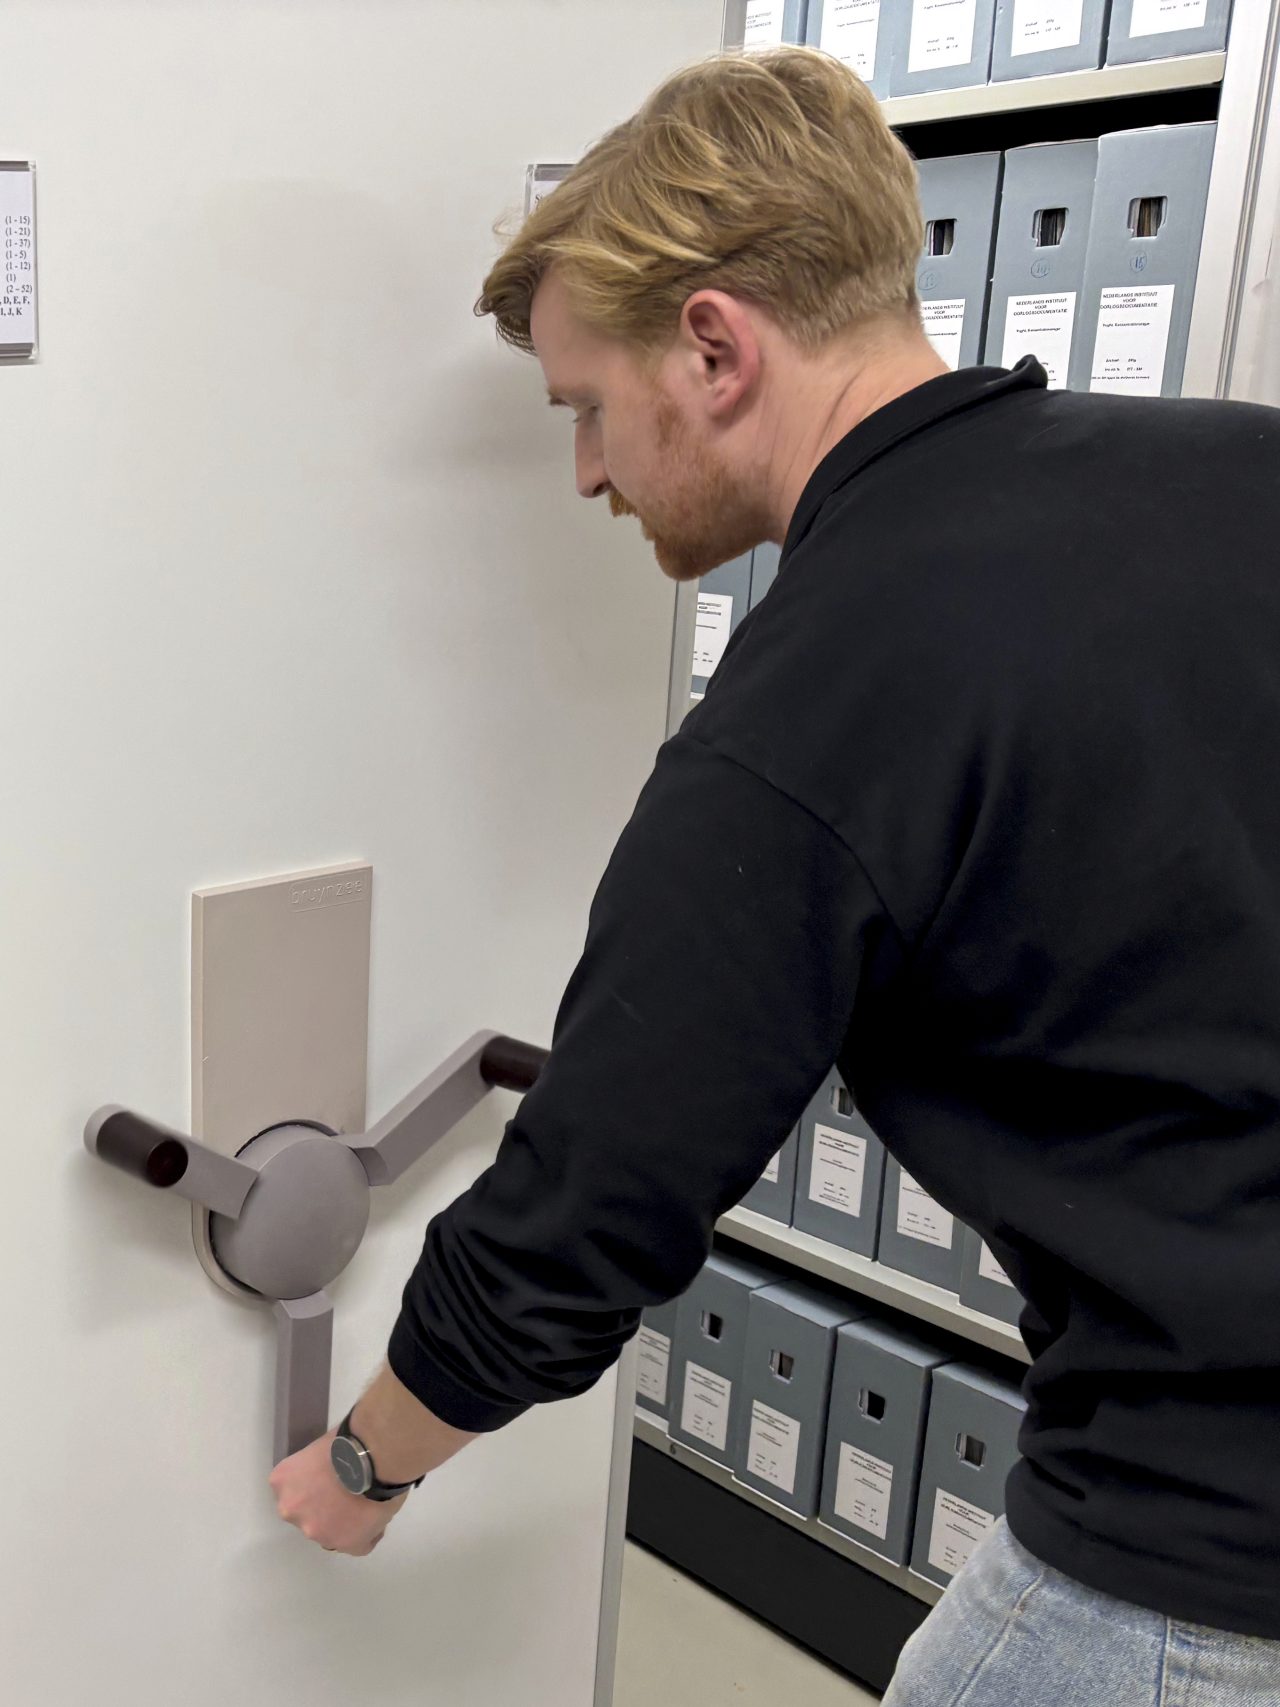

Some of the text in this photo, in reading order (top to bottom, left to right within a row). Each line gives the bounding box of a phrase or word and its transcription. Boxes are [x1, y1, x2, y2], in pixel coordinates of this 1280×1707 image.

[5, 216, 12, 225] (1
[5, 227, 12, 237] (1
[6, 239, 12, 248] (1
[6, 250, 12, 260] (1
[20, 250, 26, 259] 5)
[6, 262, 12, 271] (1
[6, 285, 14, 294] (2
[16, 307, 23, 316] K
